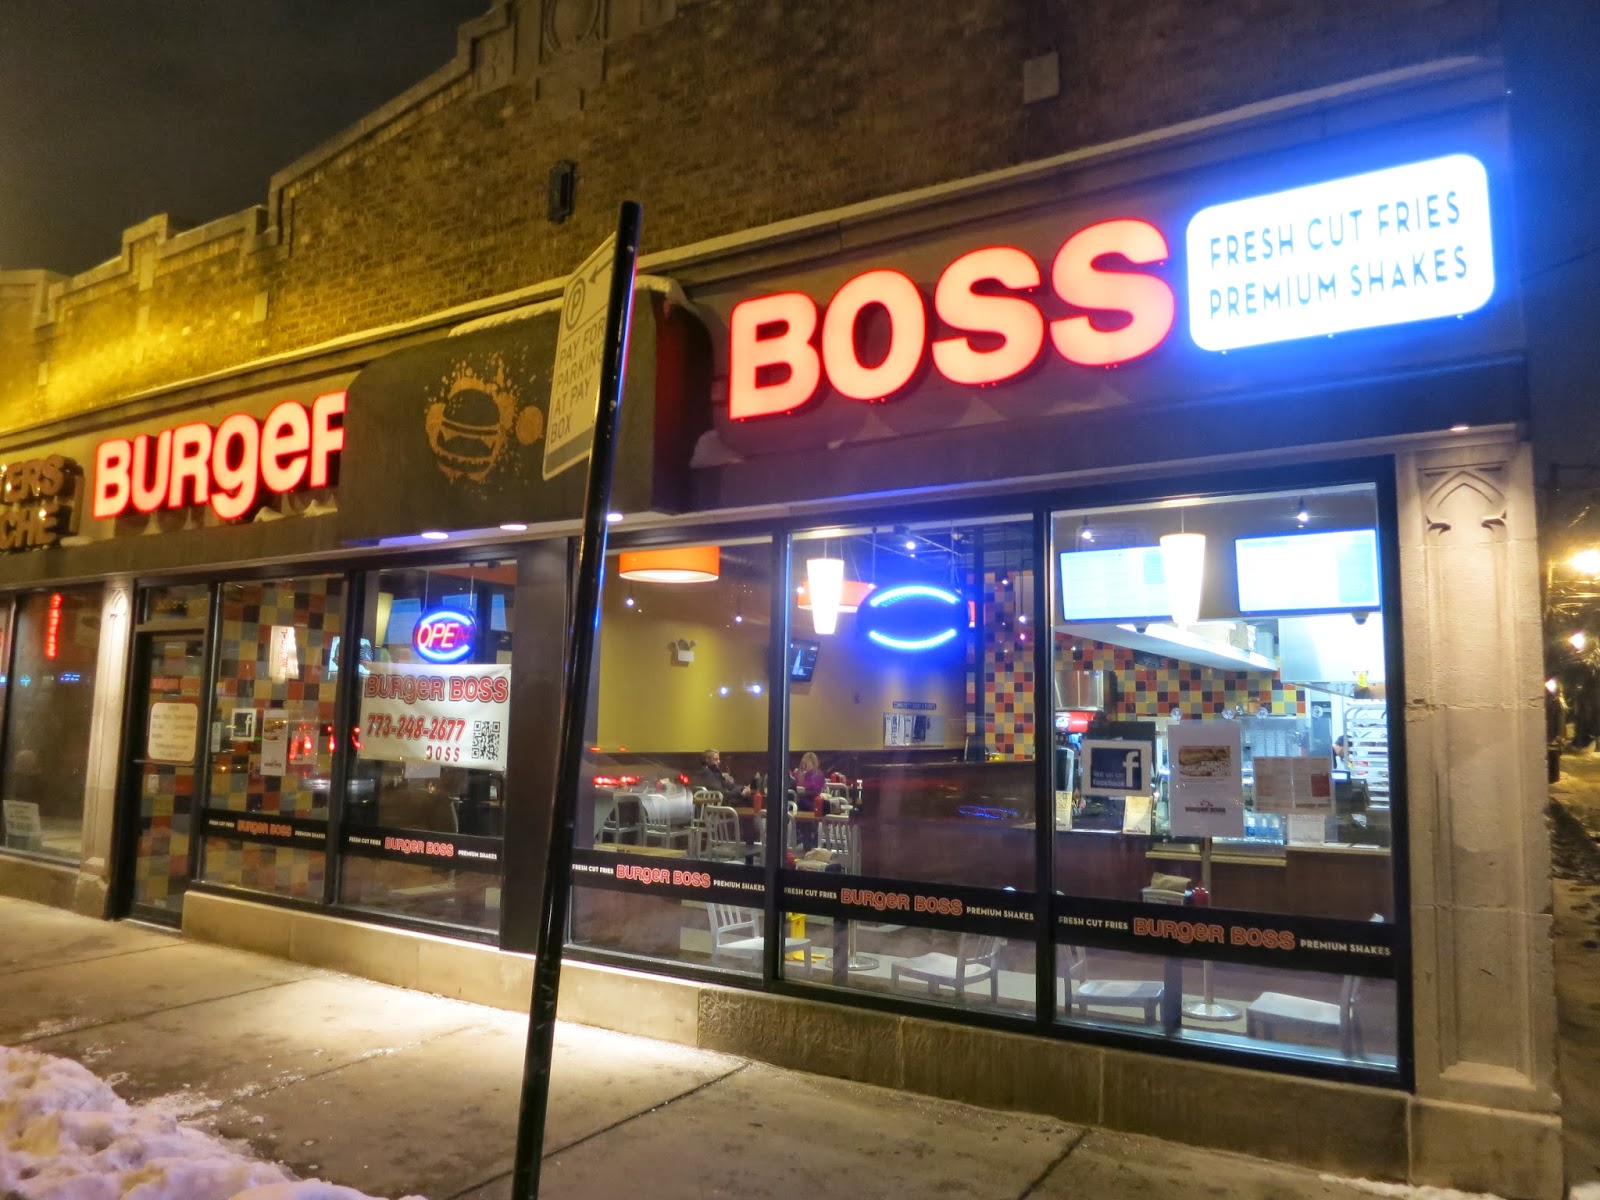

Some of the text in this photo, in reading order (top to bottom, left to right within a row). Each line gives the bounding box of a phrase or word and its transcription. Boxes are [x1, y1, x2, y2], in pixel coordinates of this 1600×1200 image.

[1210, 191, 1460, 269] FRESH CUT FRIES
[1210, 245, 1467, 319] PREMIUM SHAKES
[729, 218, 1175, 419] BOSS
[561, 338, 580, 364] PAY
[554, 376, 592, 414] AT PAY
[550, 412, 572, 443] BOX
[449, 676, 508, 703] BOSS
[367, 713, 466, 743] 773-248-2677
[426, 842, 454, 857] BOSS
[458, 850, 479, 858] PREMIUM
[572, 864, 587, 872] FRESH
[600, 867, 614, 875] FRIES
[672, 870, 711, 888] BOSS
[713, 879, 740, 889] PREMIUM
[741, 882, 765, 892] SHAKES
[784, 887, 804, 896] FRESH
[804, 889, 818, 897] CUT
[818, 890, 837, 899] FRIES
[914, 895, 963, 916] BOSS
[966, 906, 1002, 917] PREMIUM
[1003, 910, 1034, 921] SHAKES
[1058, 916, 1085, 926] FRESH
[1086, 918, 1103, 927] CUT
[1105, 920, 1128, 930] FRIES
[1231, 926, 1296, 950] BOSS
[1300, 939, 1348, 952] PREMIUM
[1350, 943, 1391, 956] SHAKES
